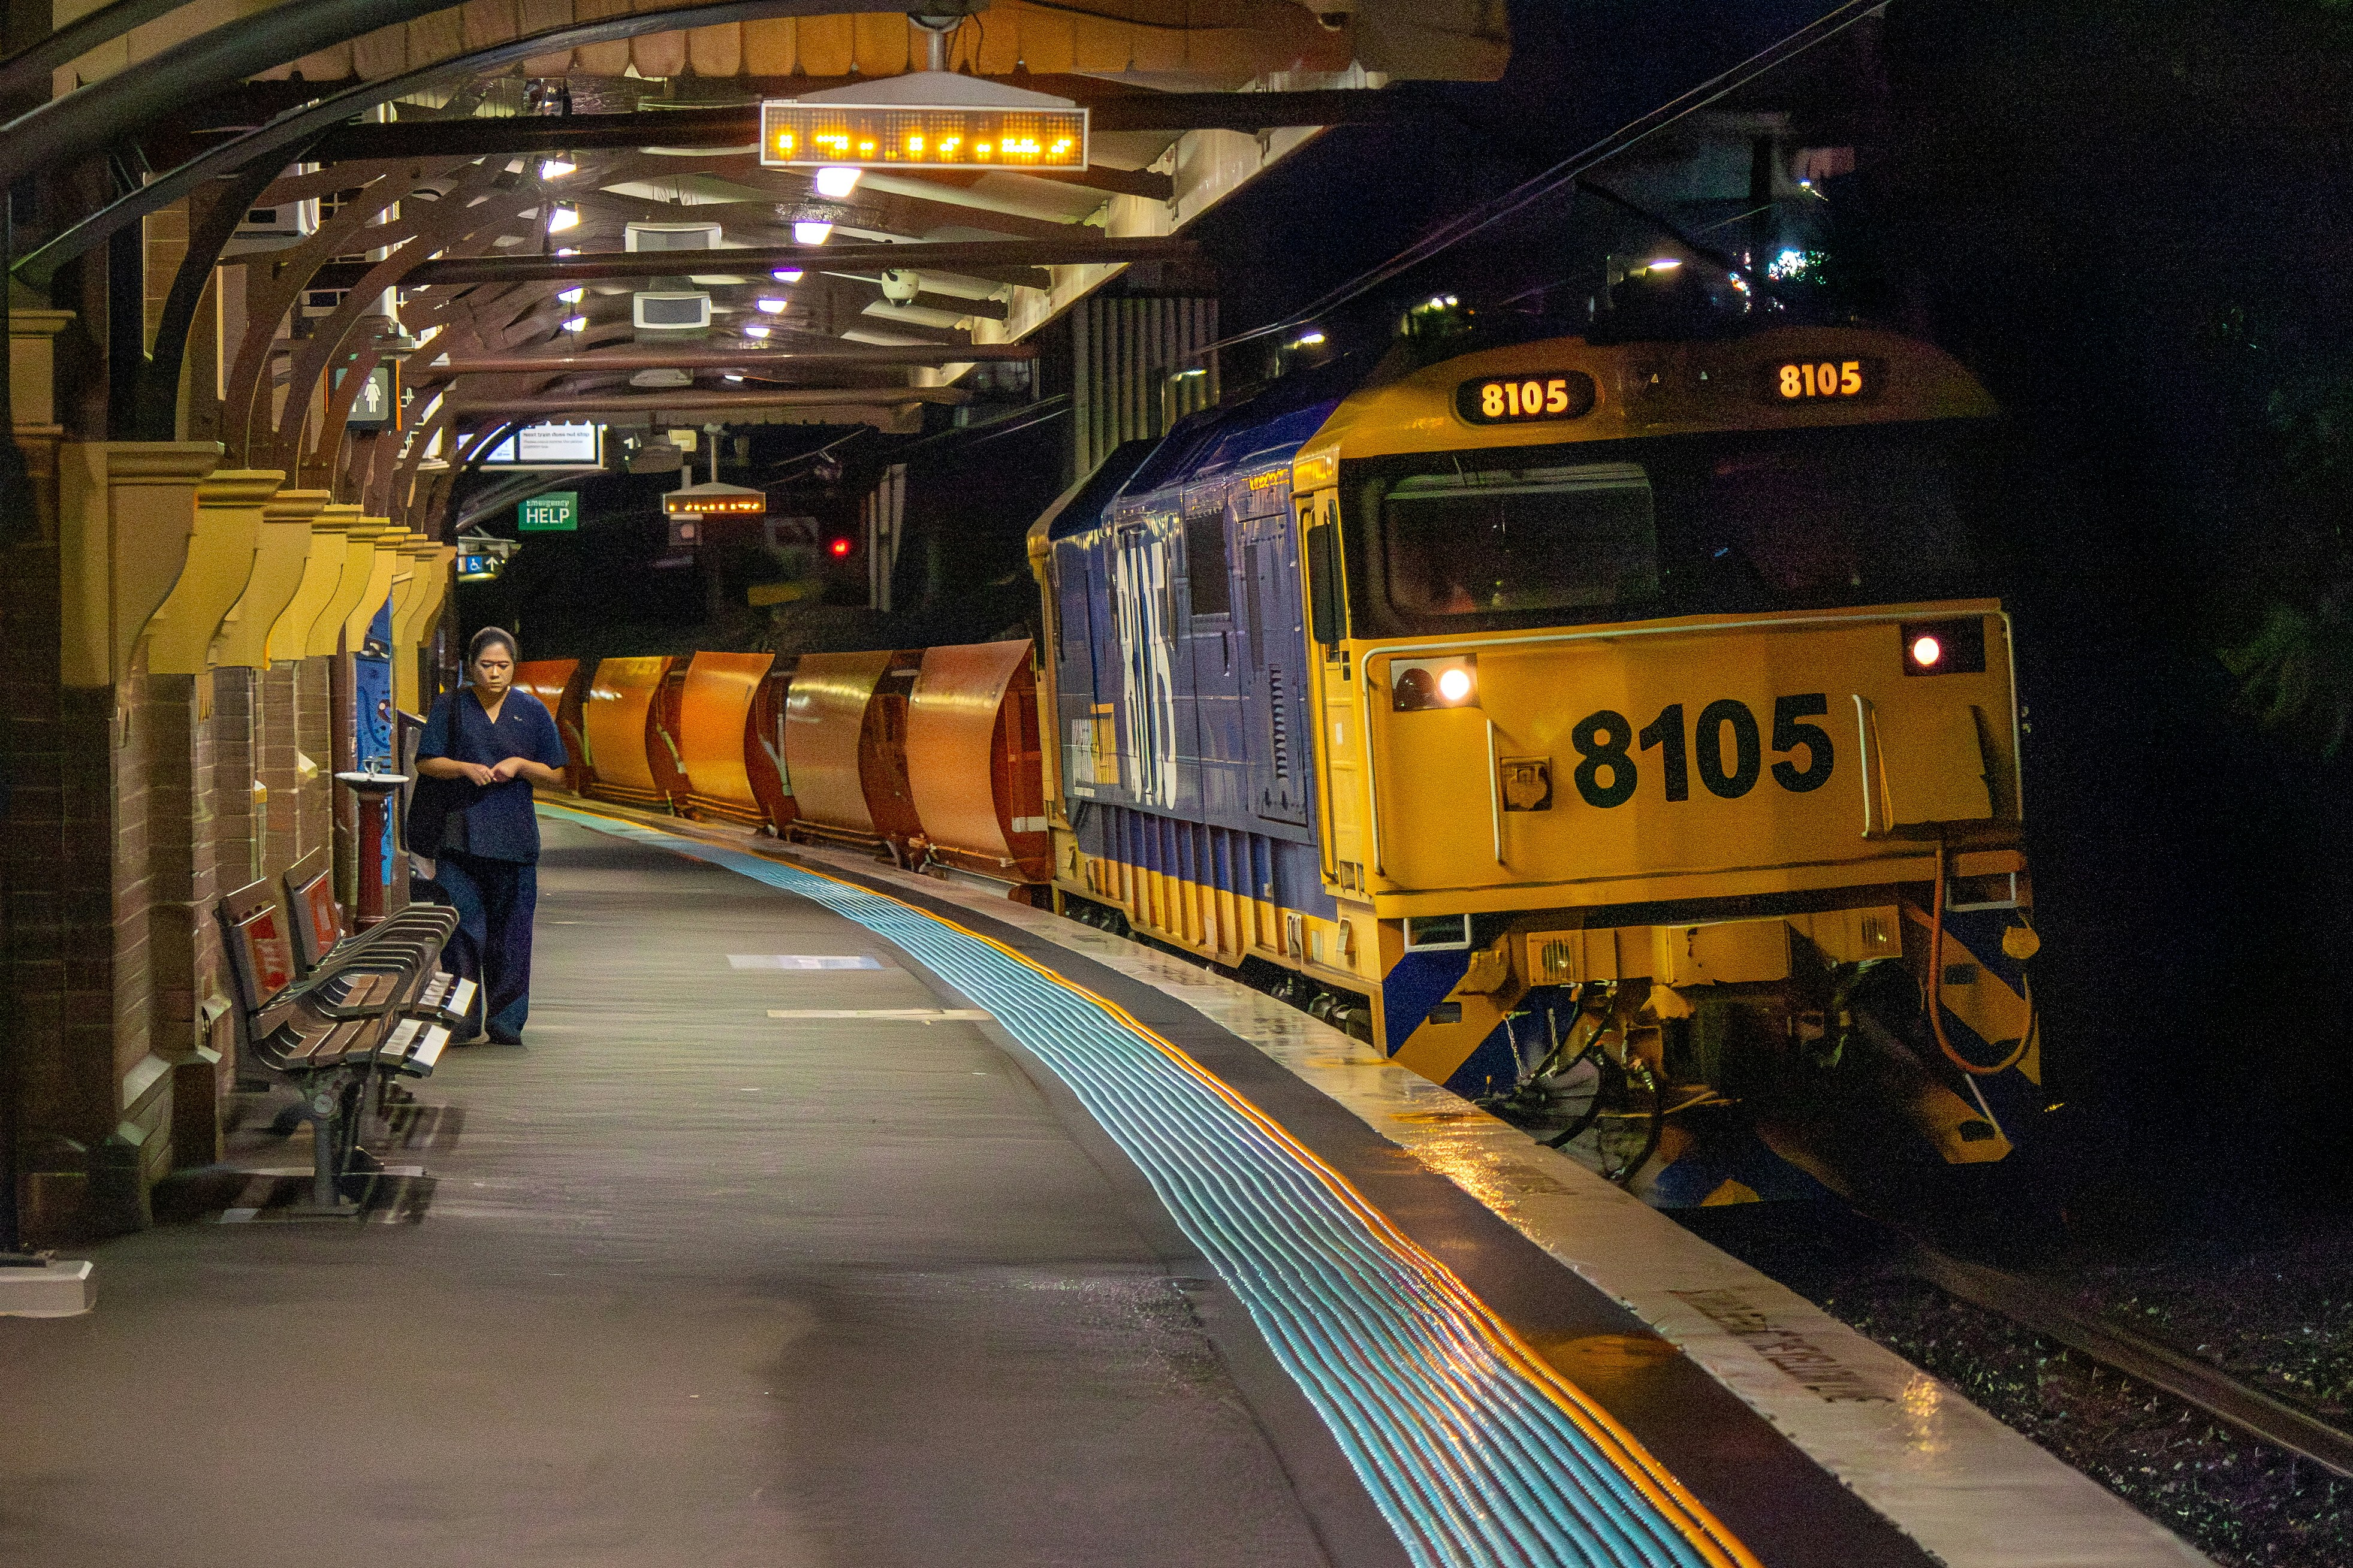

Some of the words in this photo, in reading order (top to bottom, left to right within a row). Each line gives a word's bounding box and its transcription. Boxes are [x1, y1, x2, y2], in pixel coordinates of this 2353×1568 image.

[1482, 379, 1568, 417] 8105
[1779, 361, 1862, 398] 8105
[526, 508, 569, 523] HELP
[1571, 693, 1834, 809] 8105
